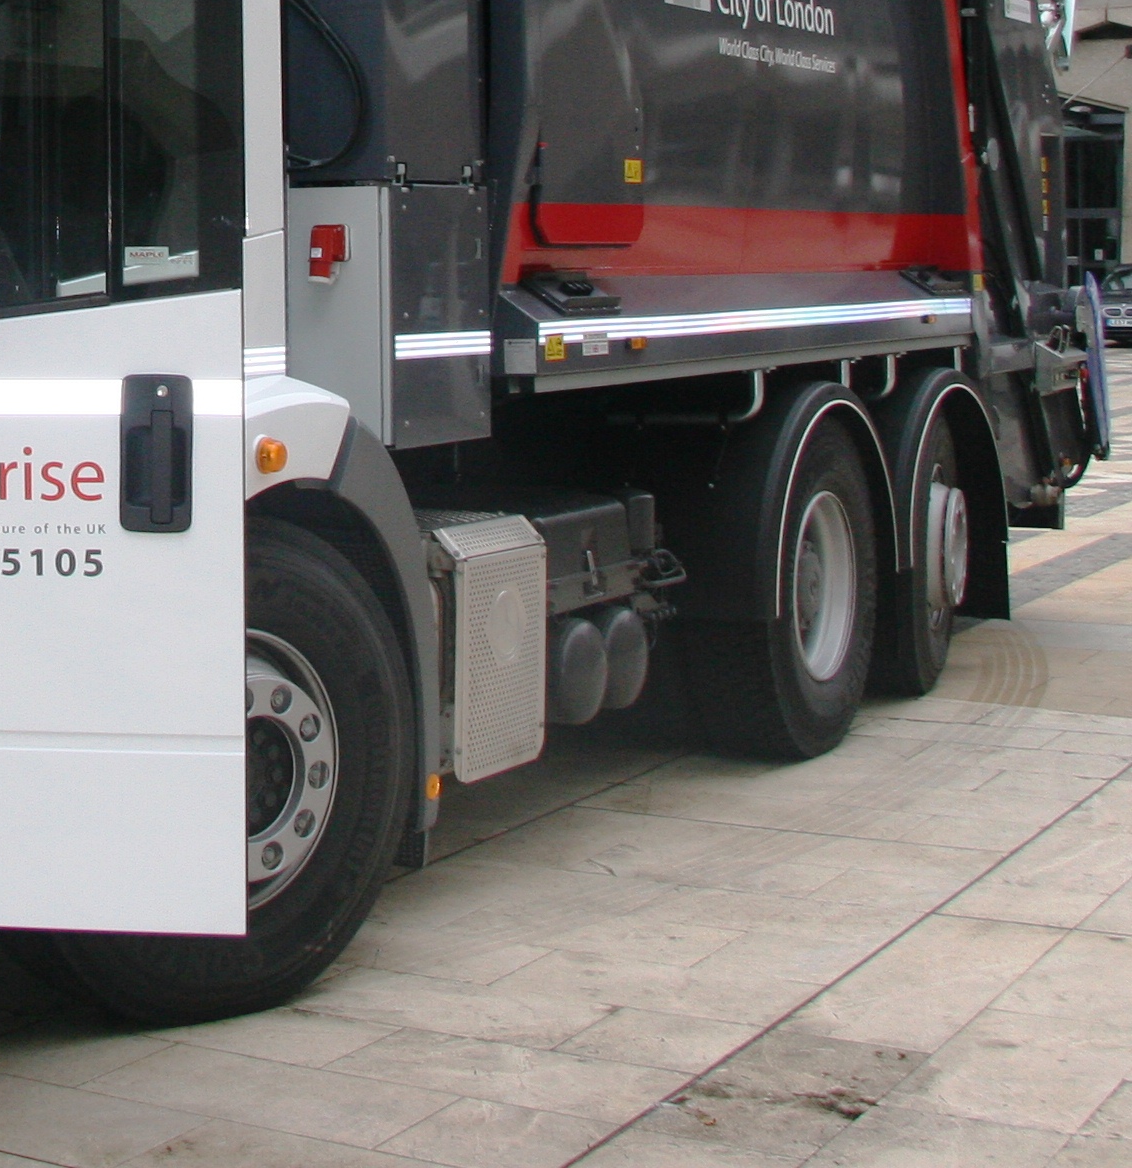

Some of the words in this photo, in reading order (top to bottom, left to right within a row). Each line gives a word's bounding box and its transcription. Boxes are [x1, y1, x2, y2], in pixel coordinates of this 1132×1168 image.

[718, 36, 742, 58] World
[742, 41, 760, 61] Class
[775, 47, 795, 66] World
[795, 51, 811, 70] Class
[811, 53, 836, 74] Services
[34, 523, 50, 534] of
[57, 523, 81, 535] the
[86, 523, 107, 535] UK
[1, 548, 104, 577] 5105
